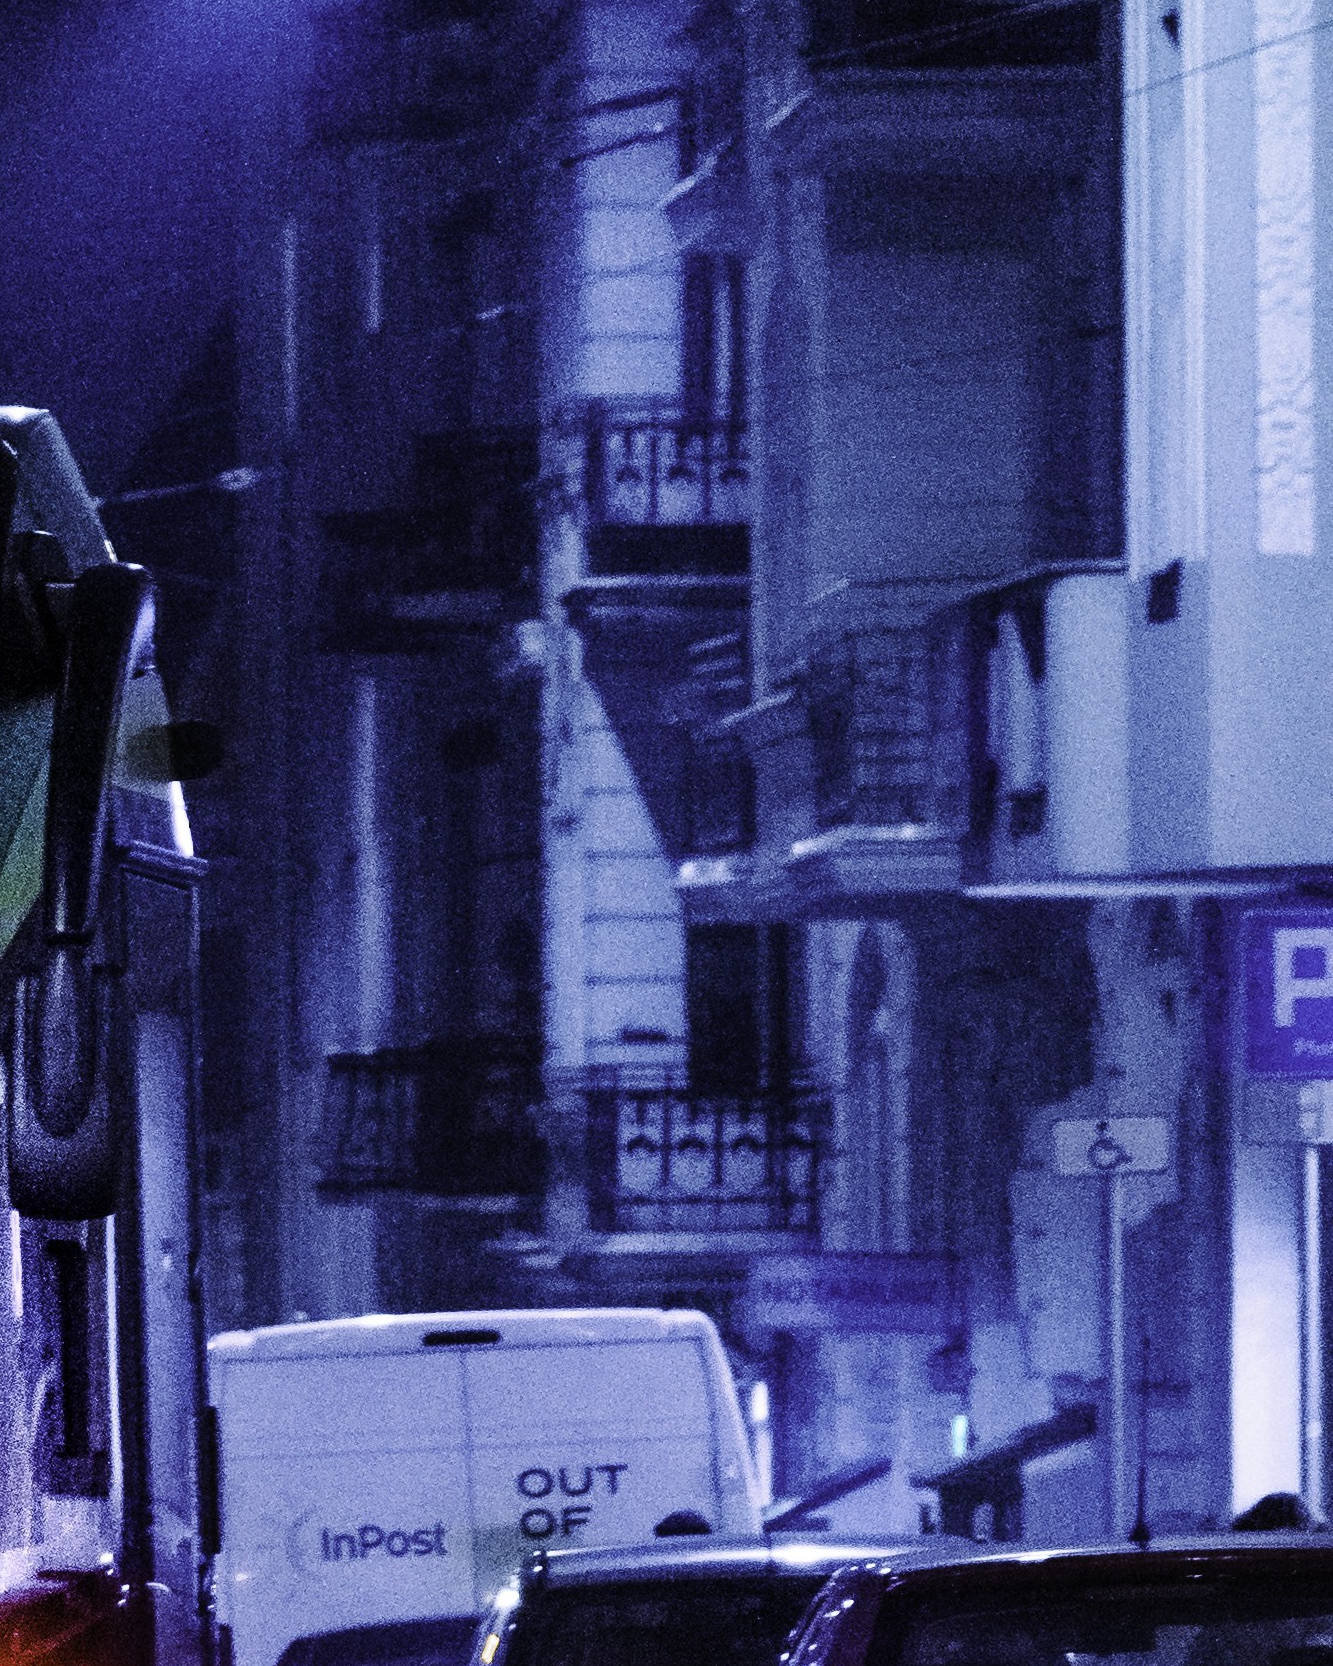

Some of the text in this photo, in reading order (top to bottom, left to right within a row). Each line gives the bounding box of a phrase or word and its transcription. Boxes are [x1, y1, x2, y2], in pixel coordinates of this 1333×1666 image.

[1273, 927, 1333, 1028] P
[517, 1463, 628, 1498] OUT
[520, 1505, 592, 1539] OF
[320, 1521, 447, 1561] InPost
